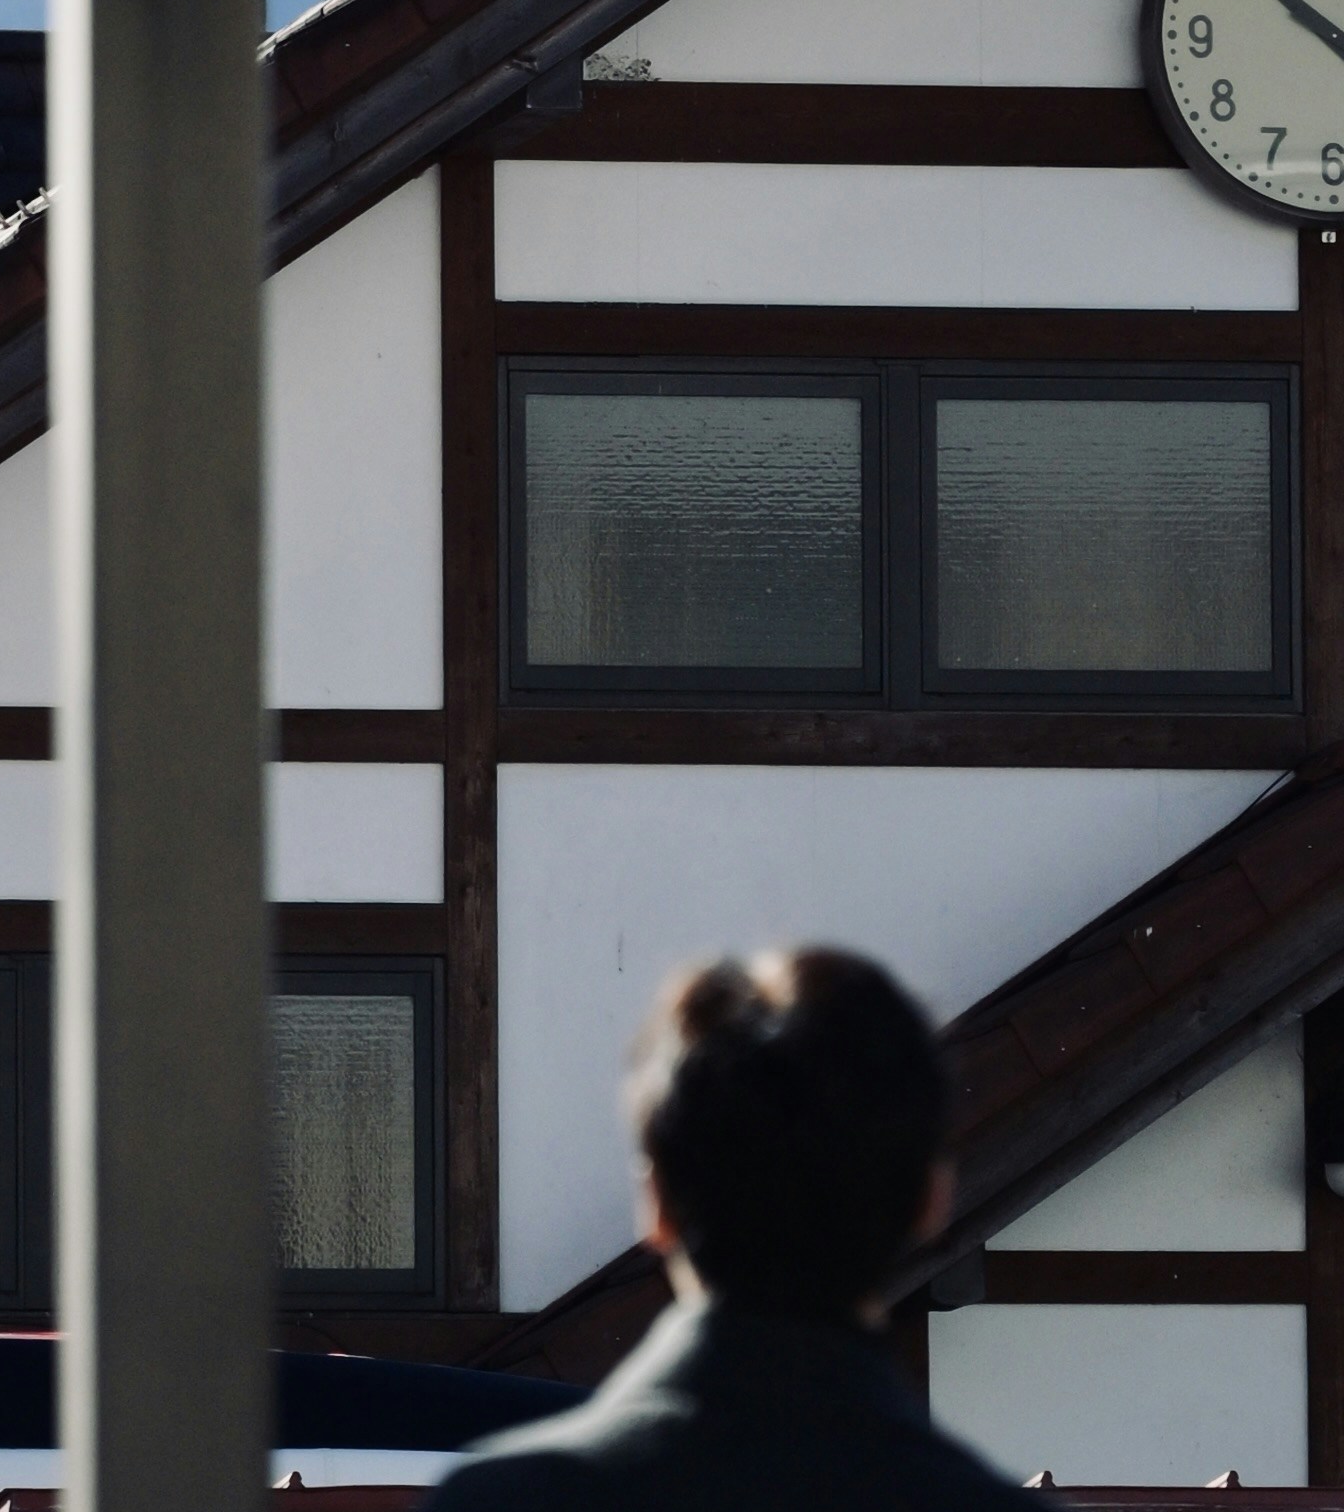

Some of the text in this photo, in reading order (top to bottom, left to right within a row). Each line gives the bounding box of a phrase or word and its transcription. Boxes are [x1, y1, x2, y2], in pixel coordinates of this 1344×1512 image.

[1188, 15, 1213, 58] 9
[1209, 79, 1236, 122] 8
[1260, 127, 1287, 170] 7
